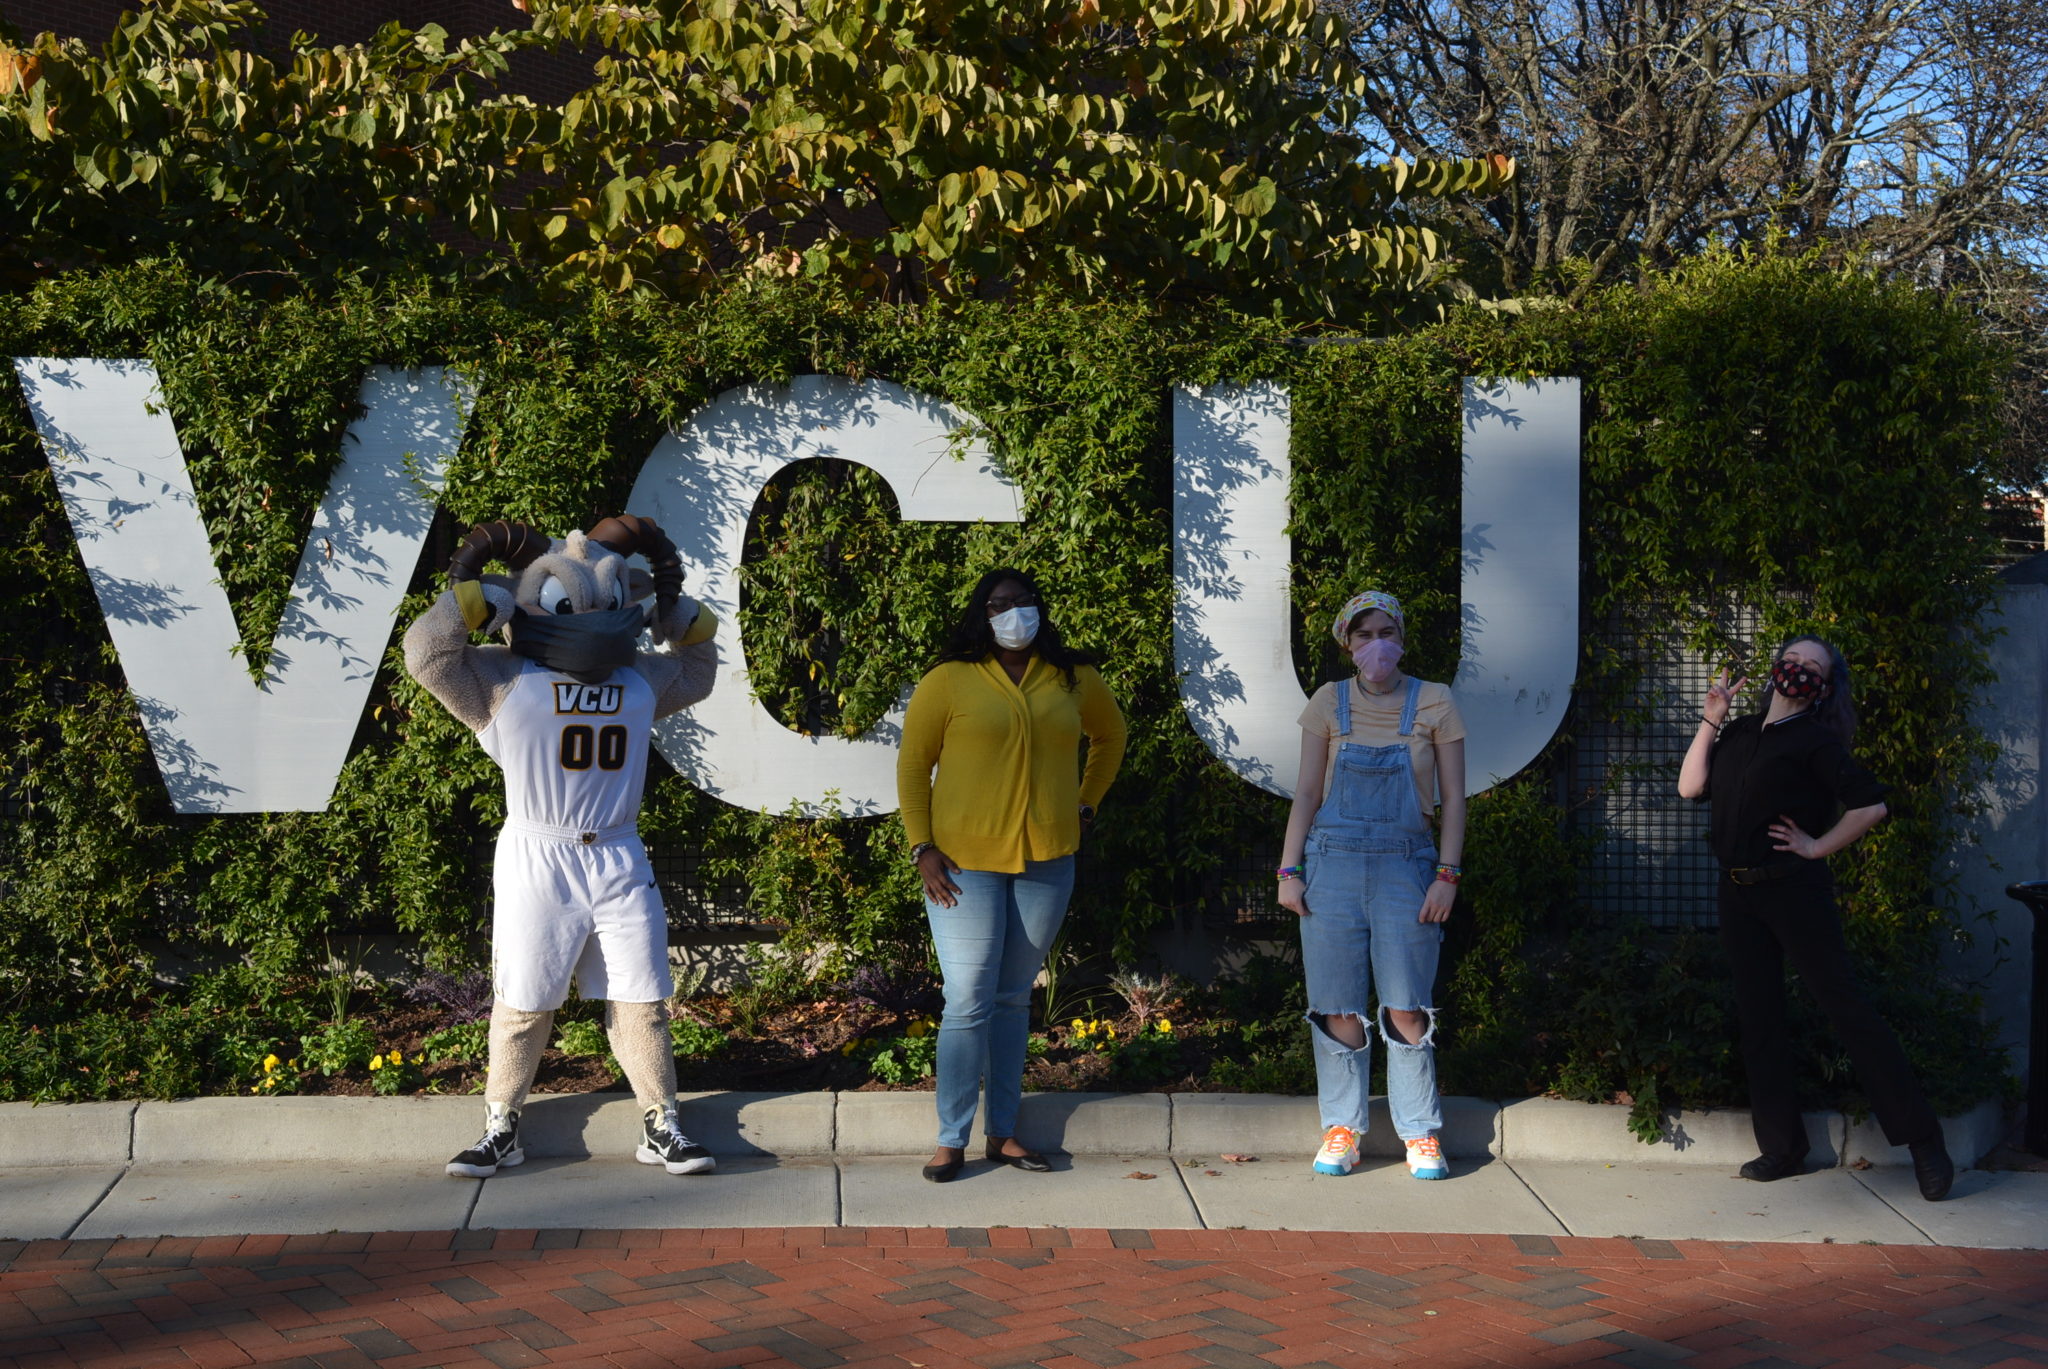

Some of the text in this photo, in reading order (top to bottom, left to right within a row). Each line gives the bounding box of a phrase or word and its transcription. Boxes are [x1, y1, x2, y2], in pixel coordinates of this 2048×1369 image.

[12, 357, 1581, 818] VCU
[554, 683, 622, 714] VCU
[561, 724, 627, 771] 00
